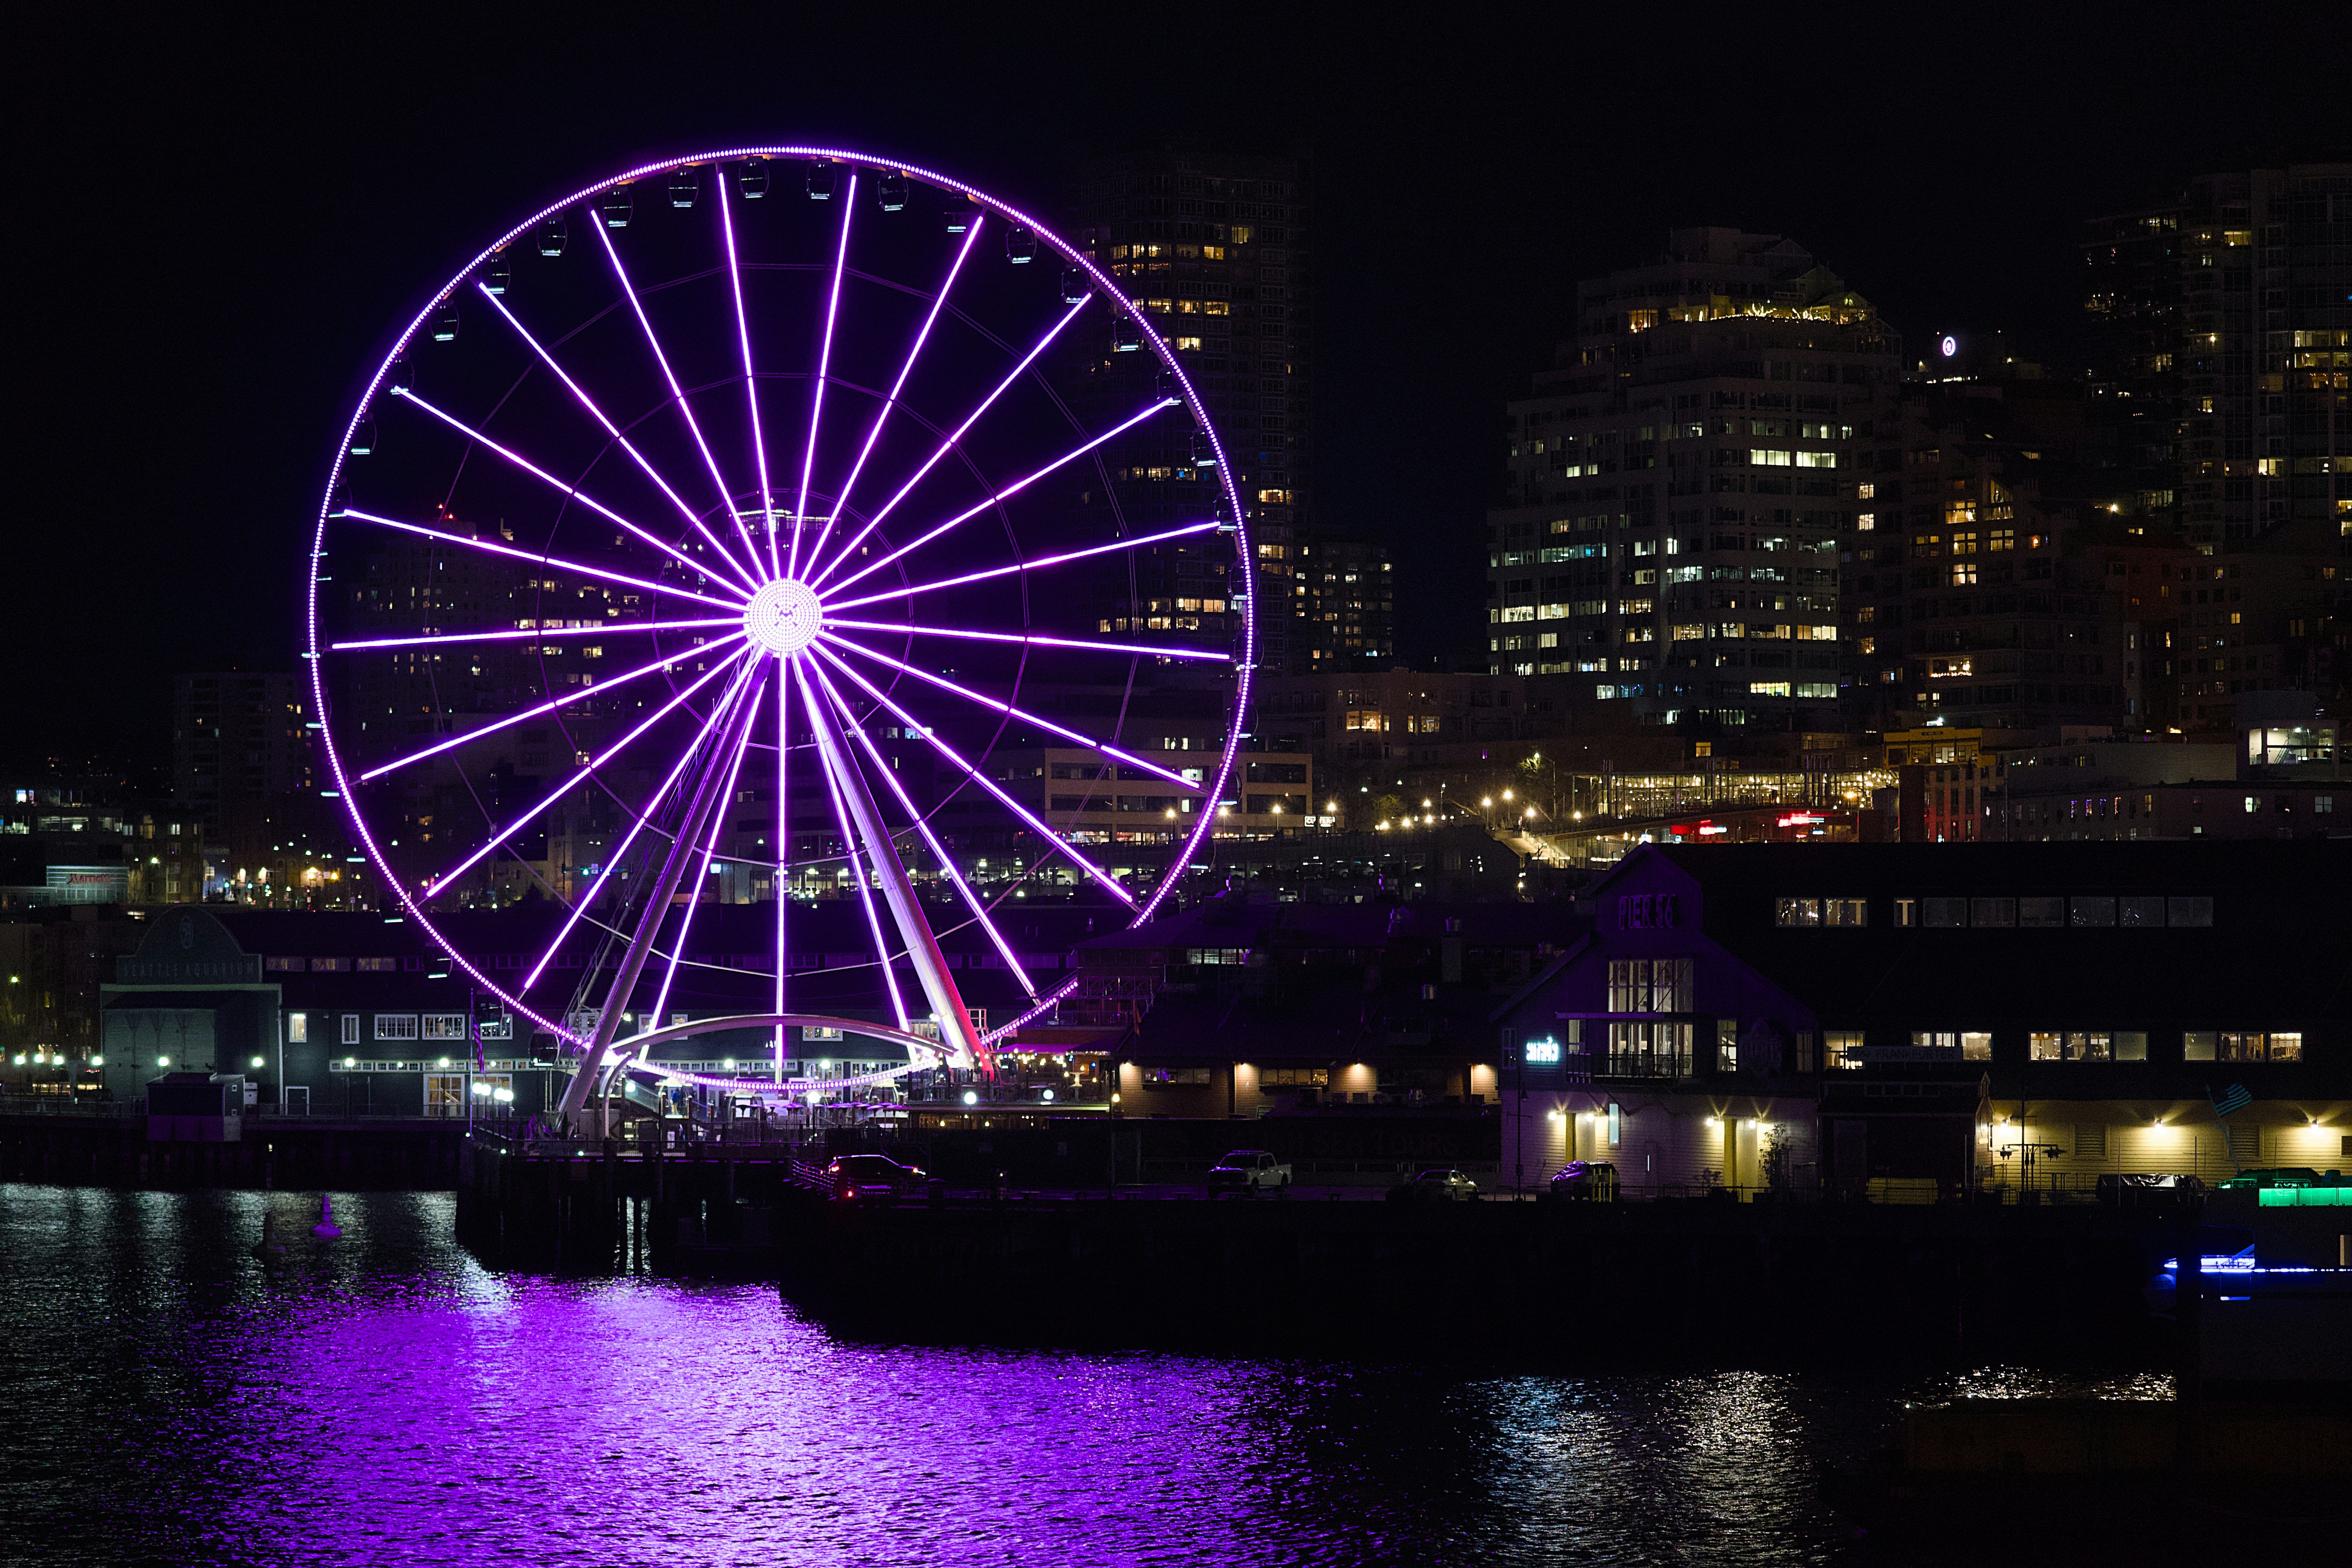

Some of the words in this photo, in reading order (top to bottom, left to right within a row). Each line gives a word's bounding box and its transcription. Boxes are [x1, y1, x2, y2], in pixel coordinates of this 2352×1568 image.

[1619, 895, 1655, 930] PIER
[1655, 894, 1676, 929] 56
[123, 963, 178, 977] SEATTLE
[185, 962, 254, 977] AQUARIUM
[1875, 1049, 1954, 1059] FRANKFURTER
